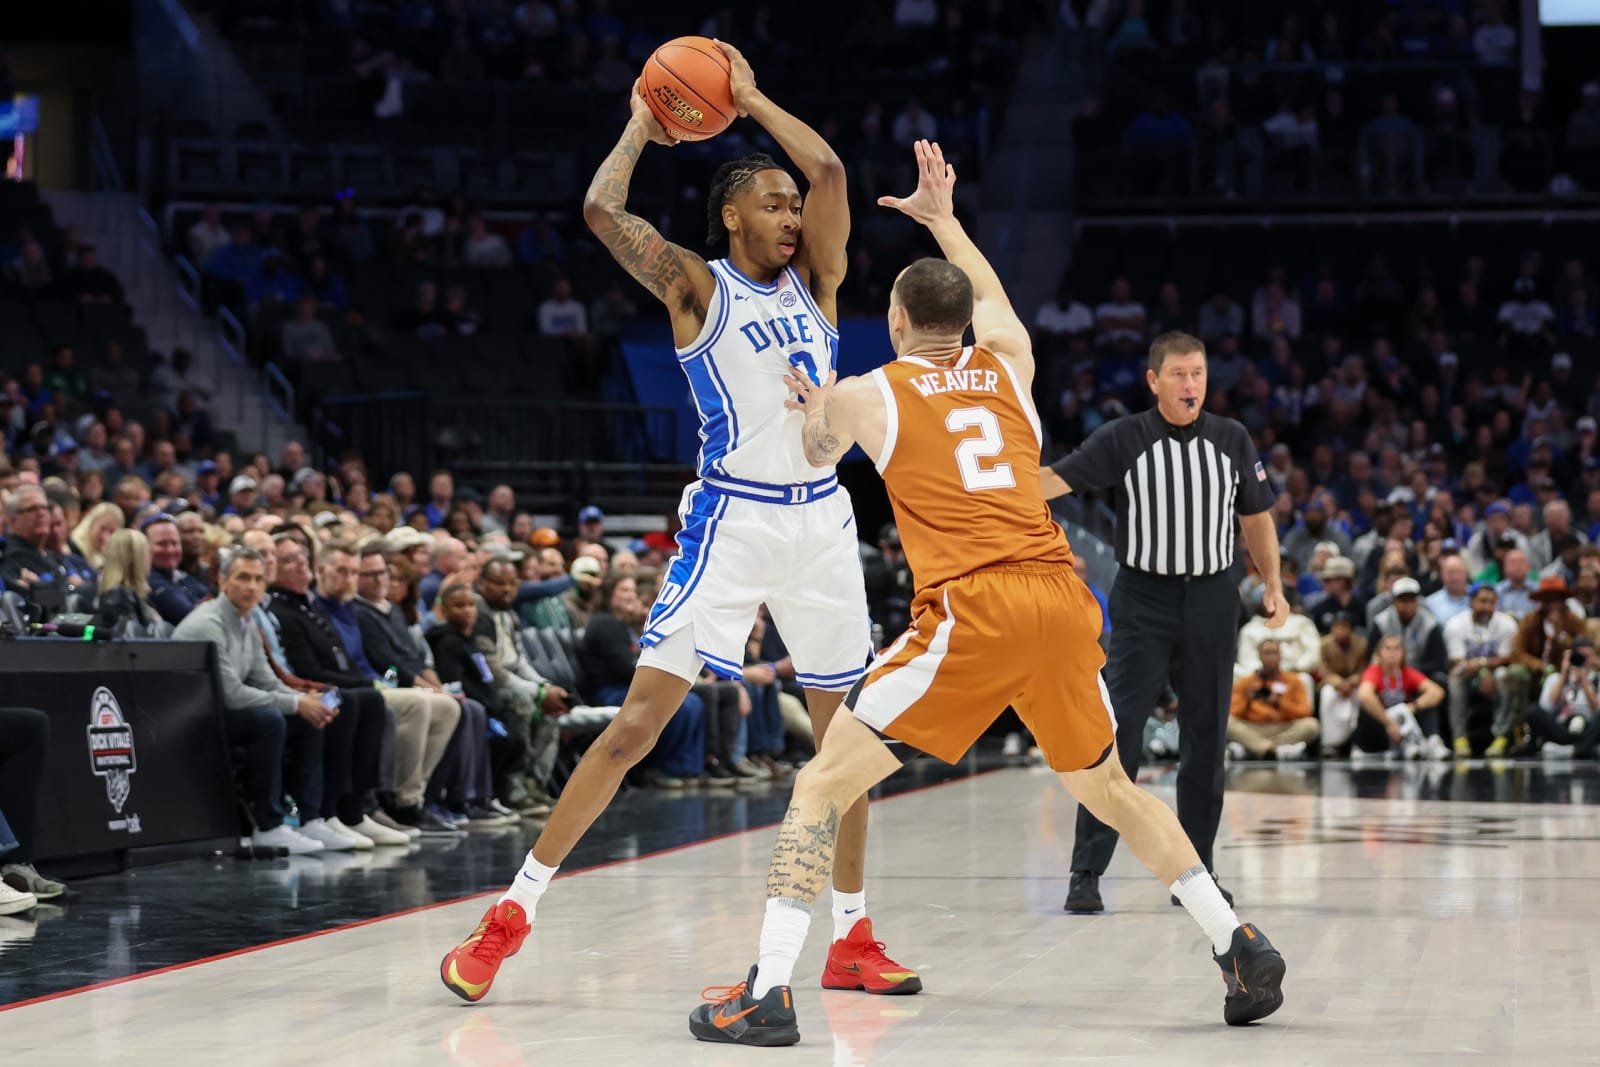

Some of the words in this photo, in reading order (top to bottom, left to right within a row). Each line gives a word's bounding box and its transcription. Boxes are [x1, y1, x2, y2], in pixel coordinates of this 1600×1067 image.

[654, 88, 703, 127] LEGACY
[740, 314, 813, 352] DUKE
[909, 369, 998, 397] WEAVER
[945, 405, 1016, 492] 2
[790, 485, 808, 504] D
